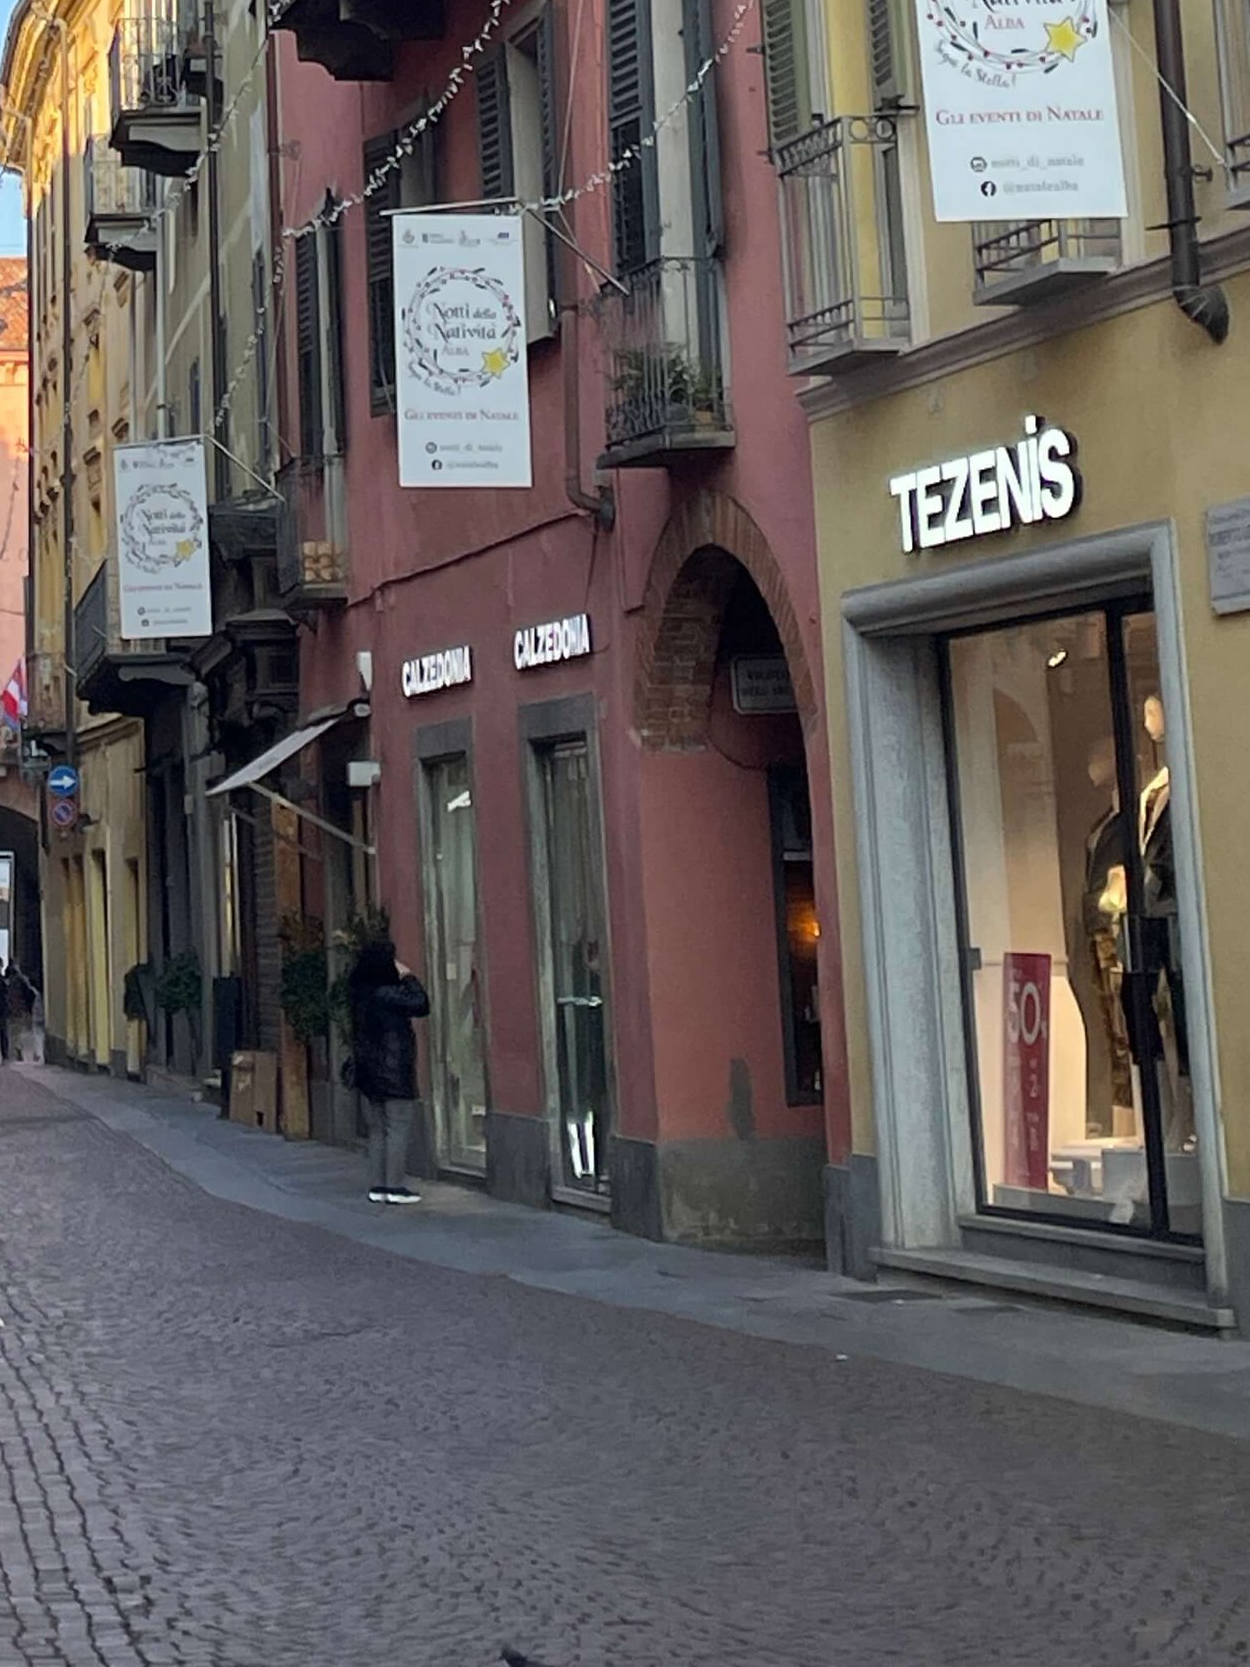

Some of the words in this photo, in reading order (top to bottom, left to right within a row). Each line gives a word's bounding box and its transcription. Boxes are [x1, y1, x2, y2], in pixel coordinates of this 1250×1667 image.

[935, 109, 964, 126] GLI
[969, 110, 1021, 125] EVENTI
[1026, 109, 1043, 122] DI
[1047, 105, 1104, 122] NATALE
[425, 301, 471, 325] Notti
[427, 322, 497, 344] Natività
[513, 613, 592, 671] CALZEDONIA
[402, 645, 472, 698] CALZEDONIA
